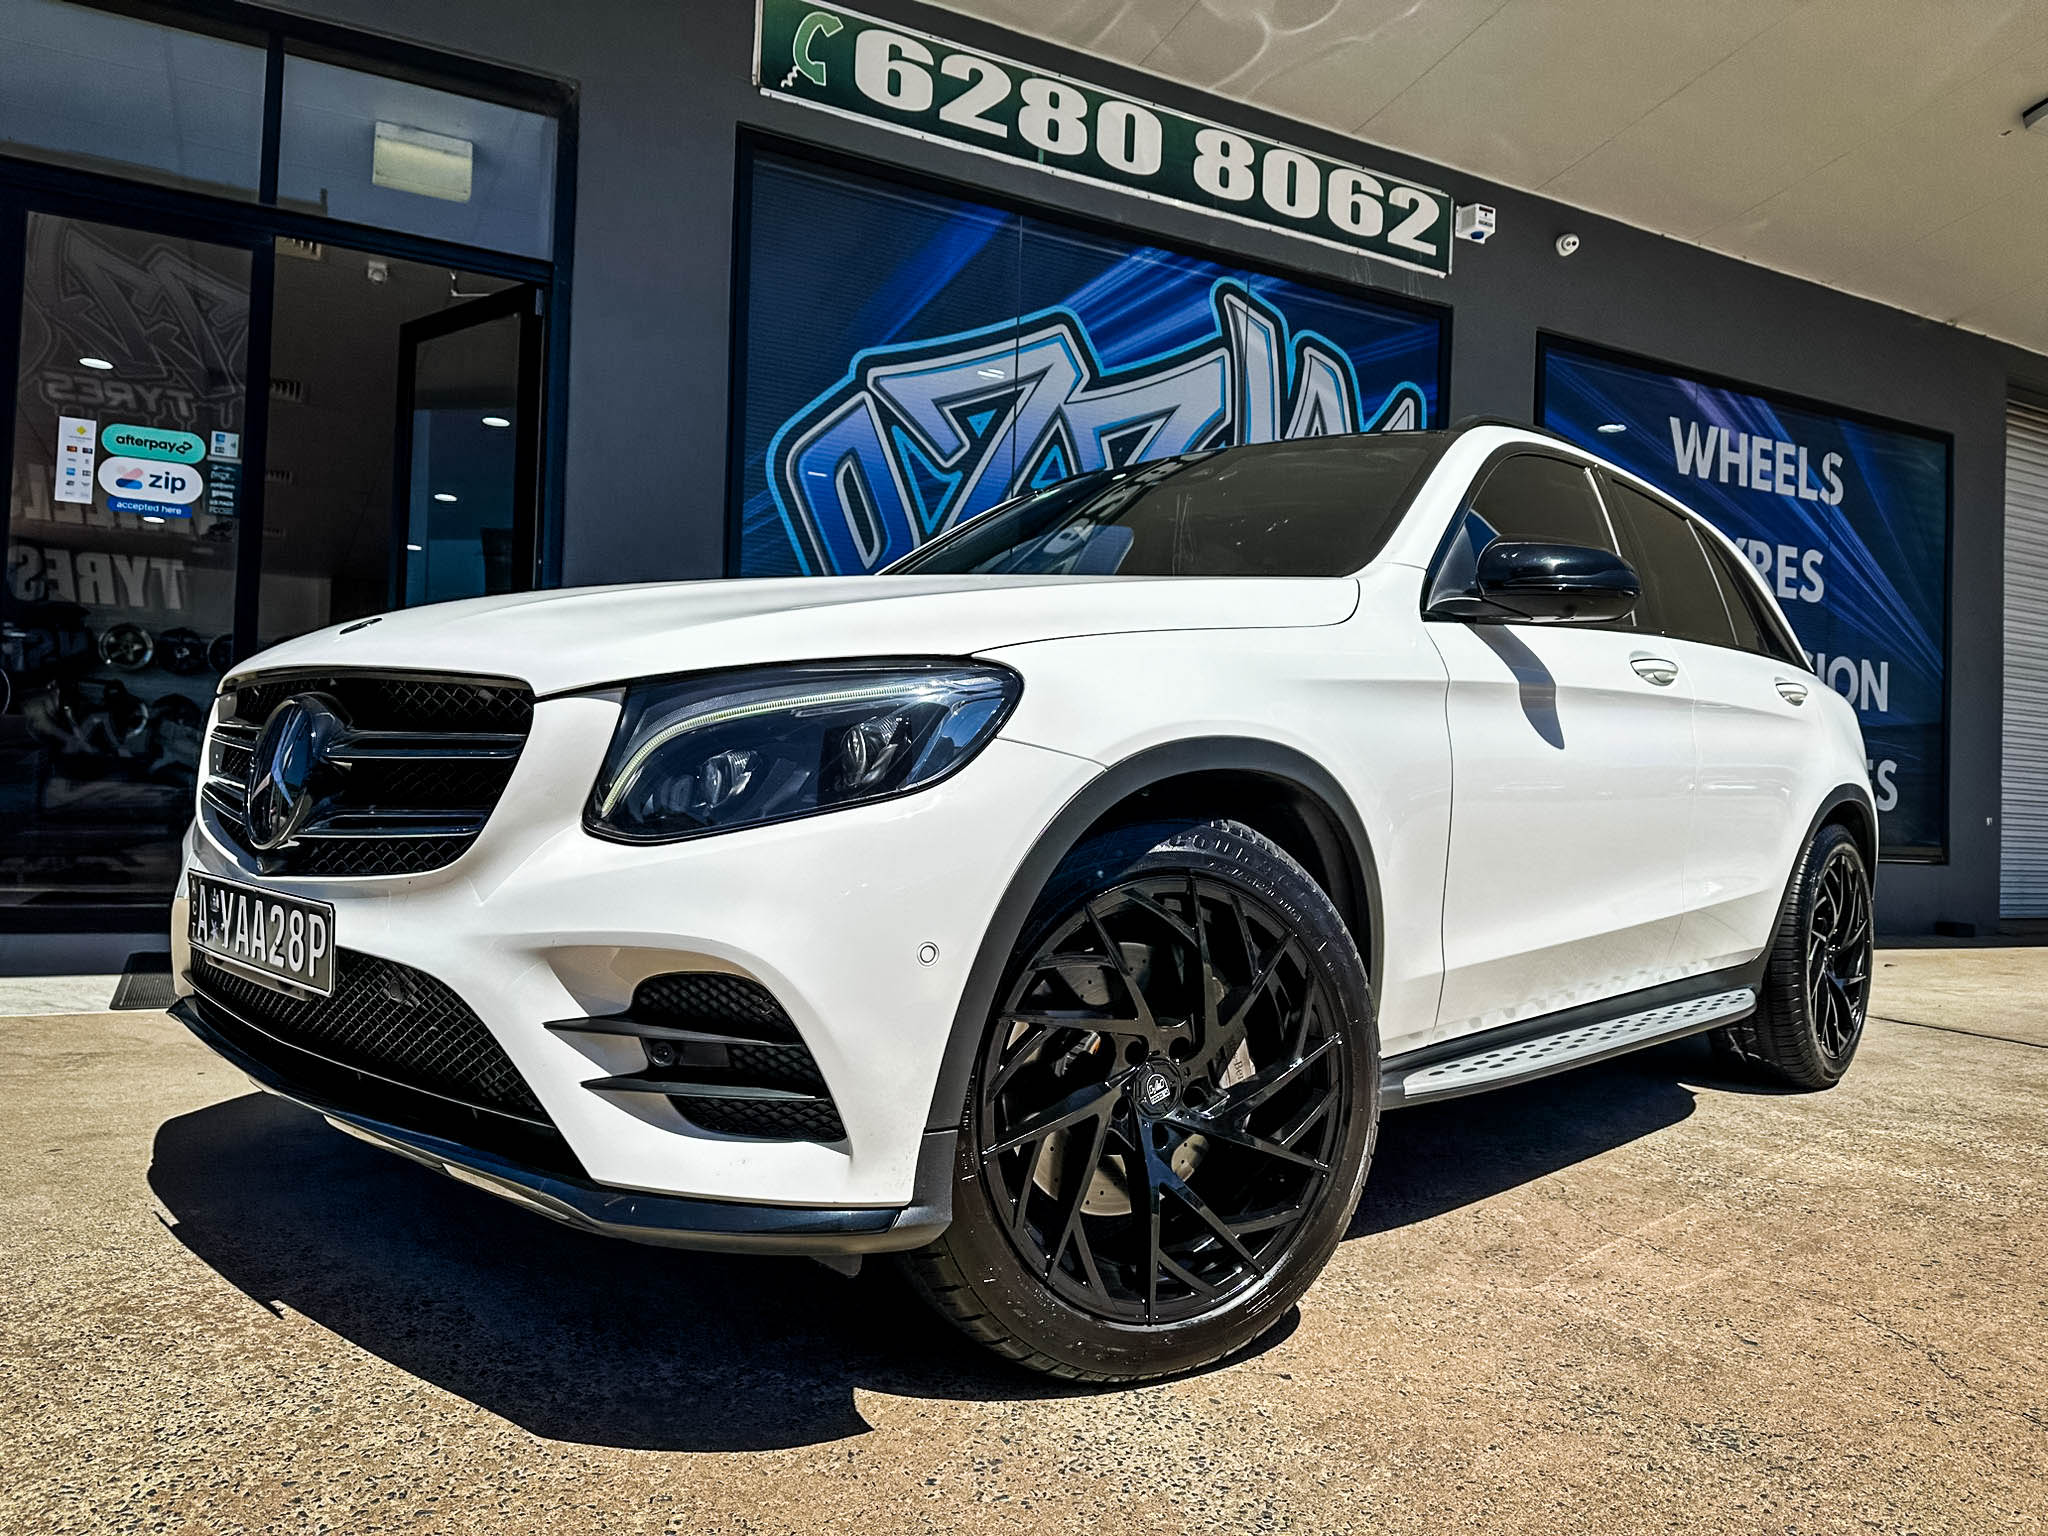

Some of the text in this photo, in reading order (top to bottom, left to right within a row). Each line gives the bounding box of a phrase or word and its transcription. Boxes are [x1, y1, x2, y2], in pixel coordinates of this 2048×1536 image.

[855, 28, 1440, 256] 6280 8062
[115, 434, 177, 453] afterpay
[1669, 417, 1844, 505] WHEELS
[149, 471, 187, 494] zip
[117, 501, 183, 515] accepted here
